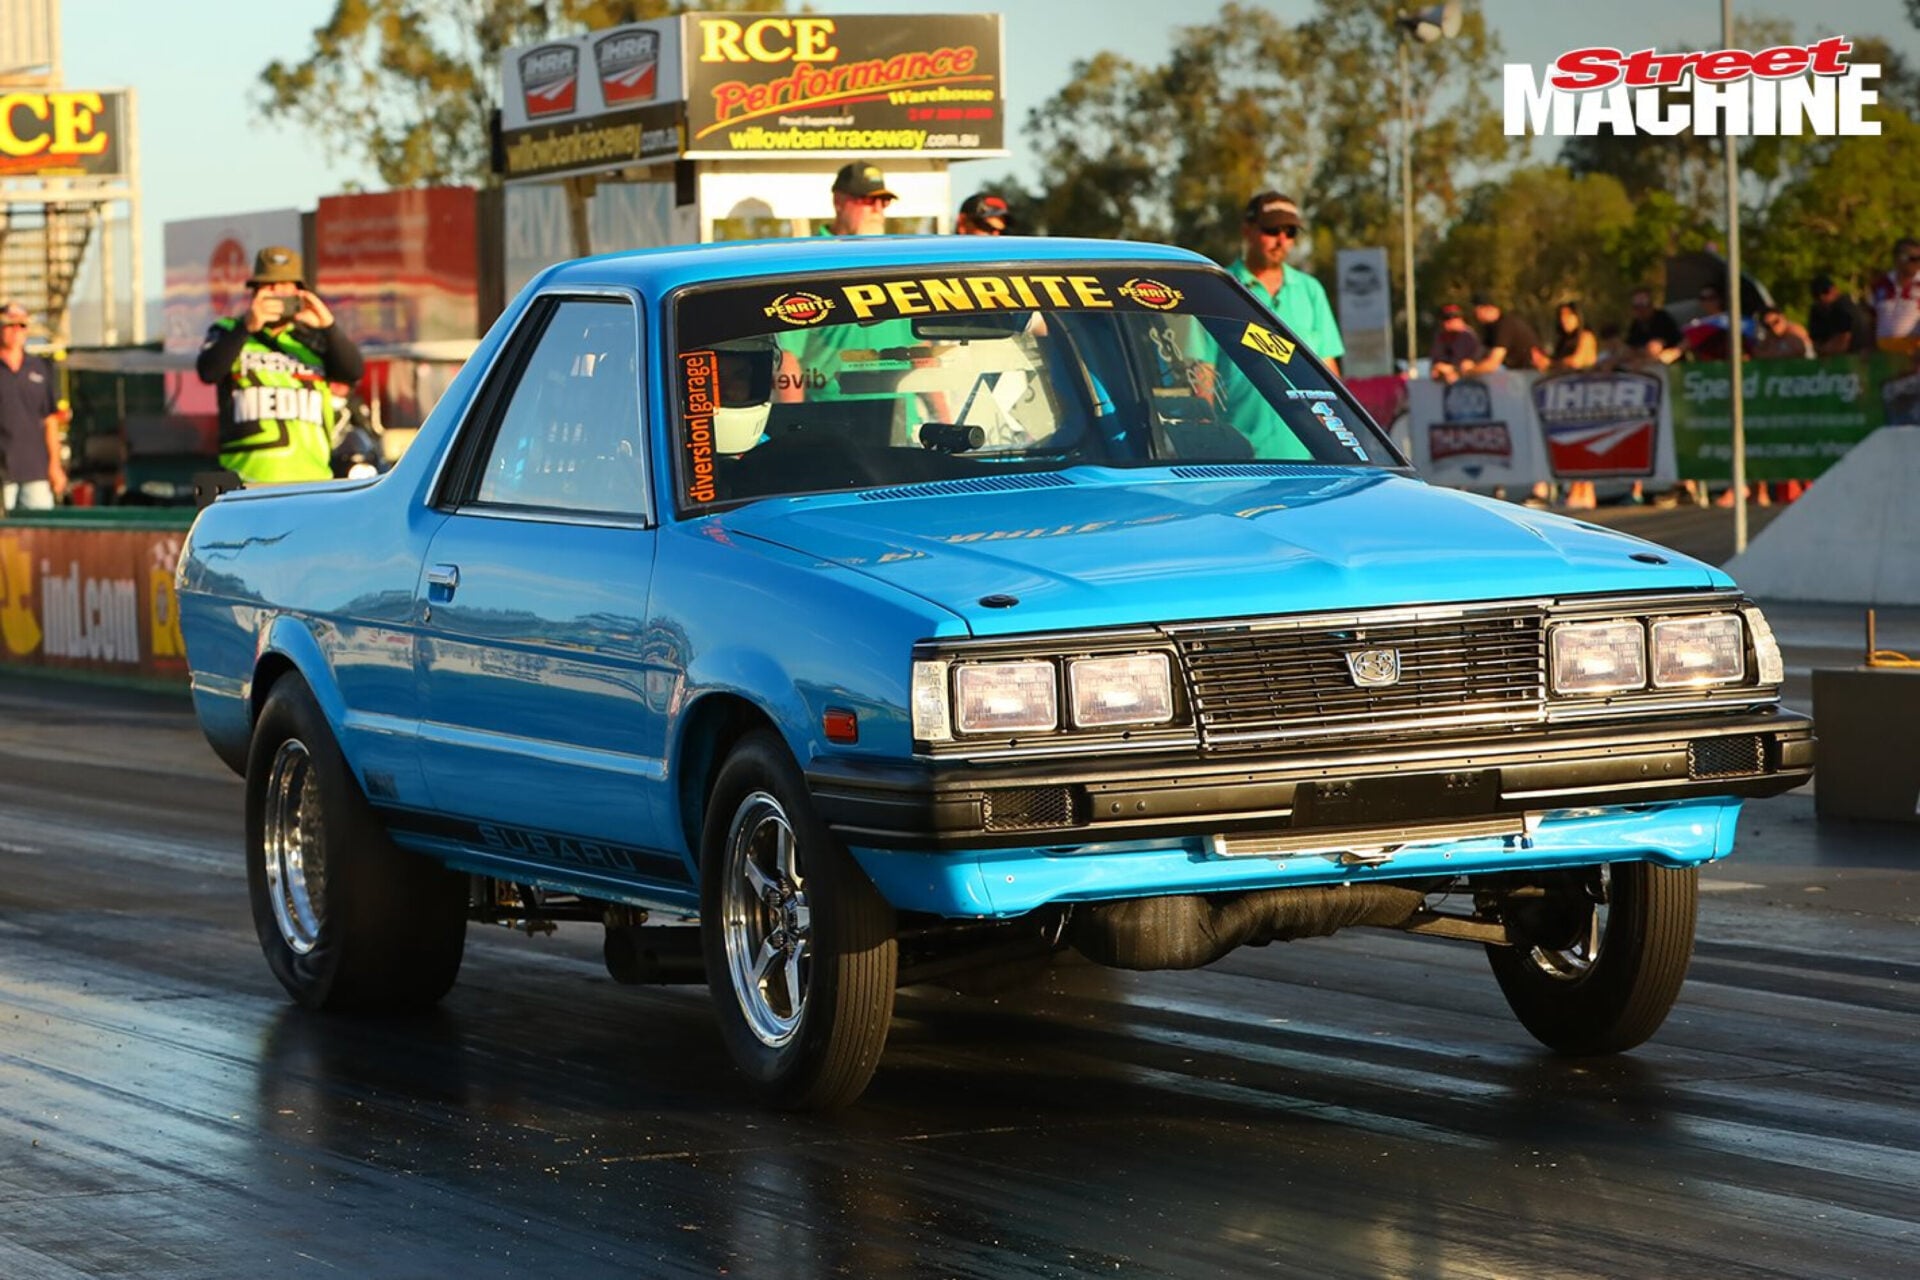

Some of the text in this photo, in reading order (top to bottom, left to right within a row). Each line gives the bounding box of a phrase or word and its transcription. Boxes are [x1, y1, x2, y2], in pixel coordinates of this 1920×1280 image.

[700, 18, 839, 63] RCE
[710, 45, 978, 121] Performance
[888, 86, 995, 106] Warehouse
[729, 126, 980, 151] willowbankraceway.com.au
[764, 297, 836, 318] PENRITE
[841, 276, 1114, 319] PENRITE
[1117, 285, 1186, 301] PENRITE
[232, 385, 324, 427] MEDIA
[1543, 381, 1647, 409] IHRA
[478, 823, 637, 871] SUBARU
